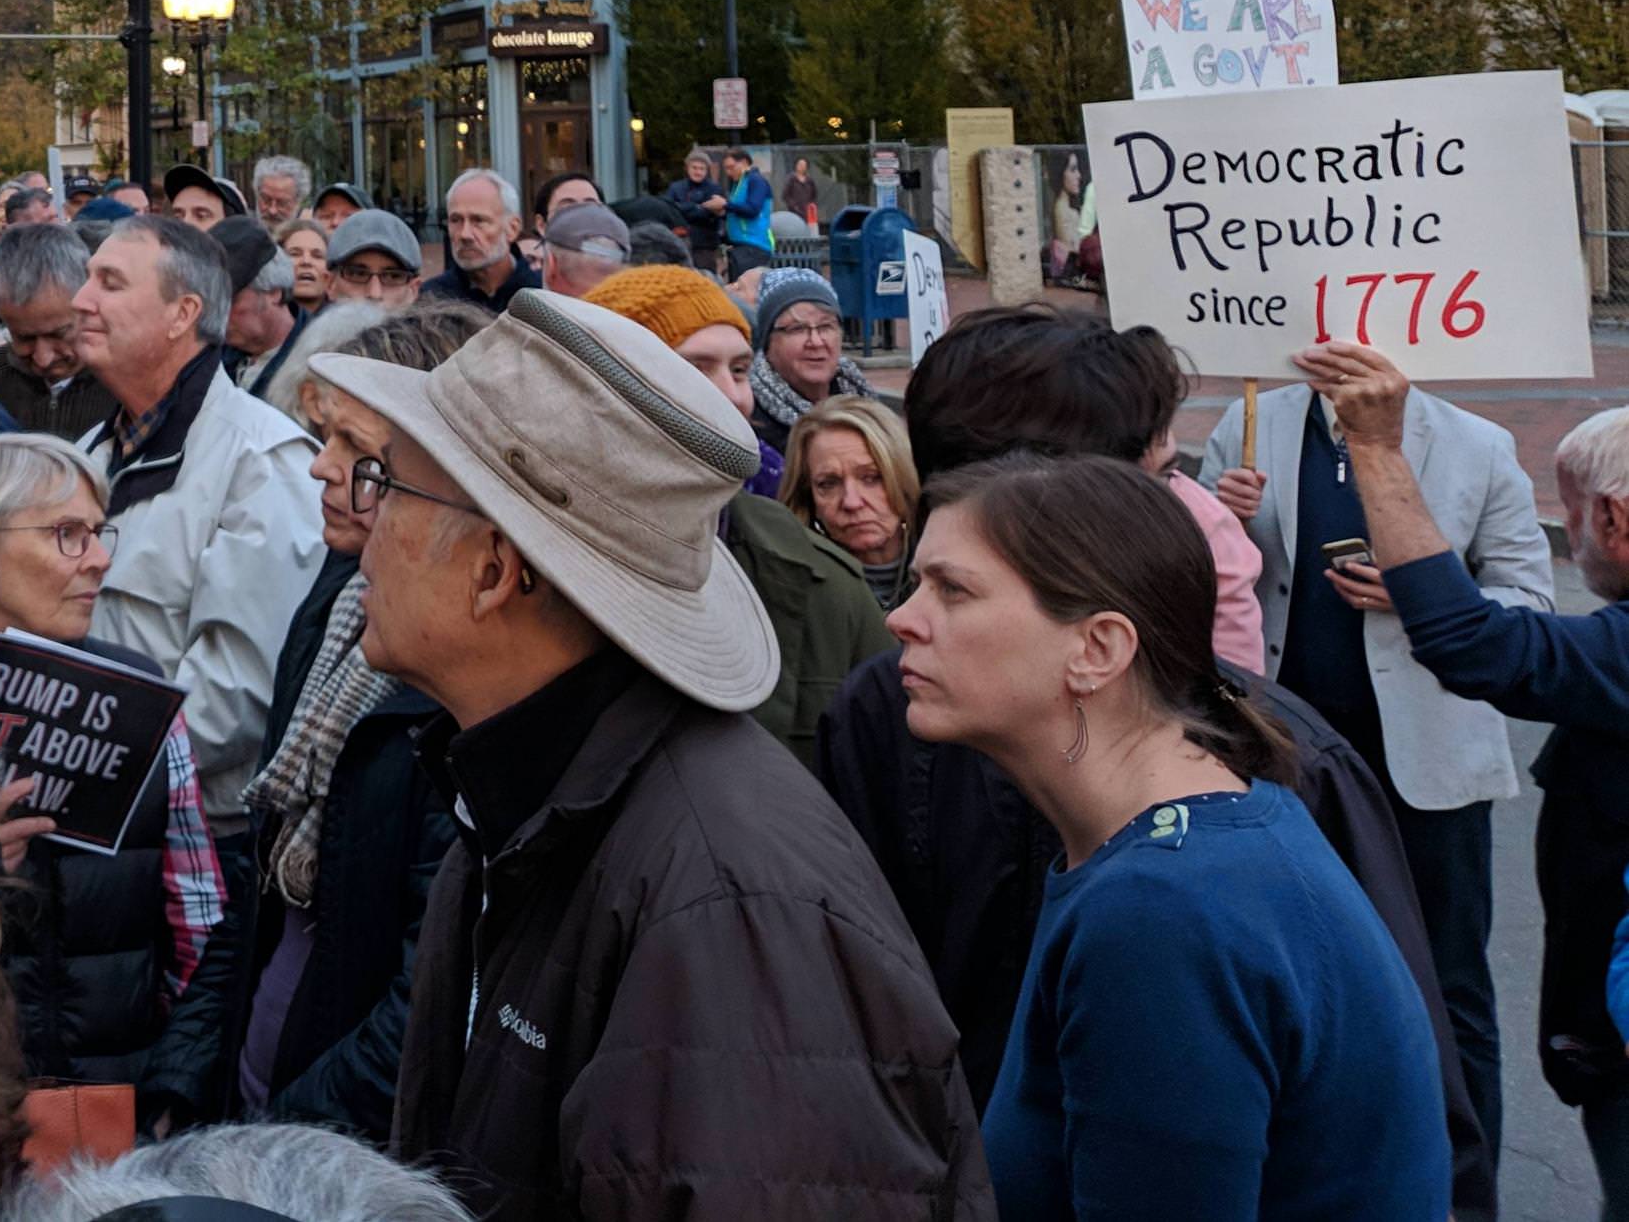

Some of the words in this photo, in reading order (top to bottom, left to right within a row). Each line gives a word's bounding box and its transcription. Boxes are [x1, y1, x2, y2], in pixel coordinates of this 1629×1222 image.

[492, 31, 546, 48] chocolate
[547, 29, 595, 49] lounge
[1163, 194, 1441, 272] Republic
[1187, 287, 1287, 326] since
[1314, 269, 1486, 345] 1776
[81, 691, 118, 731] IS
[19, 721, 130, 781] ABOVE
